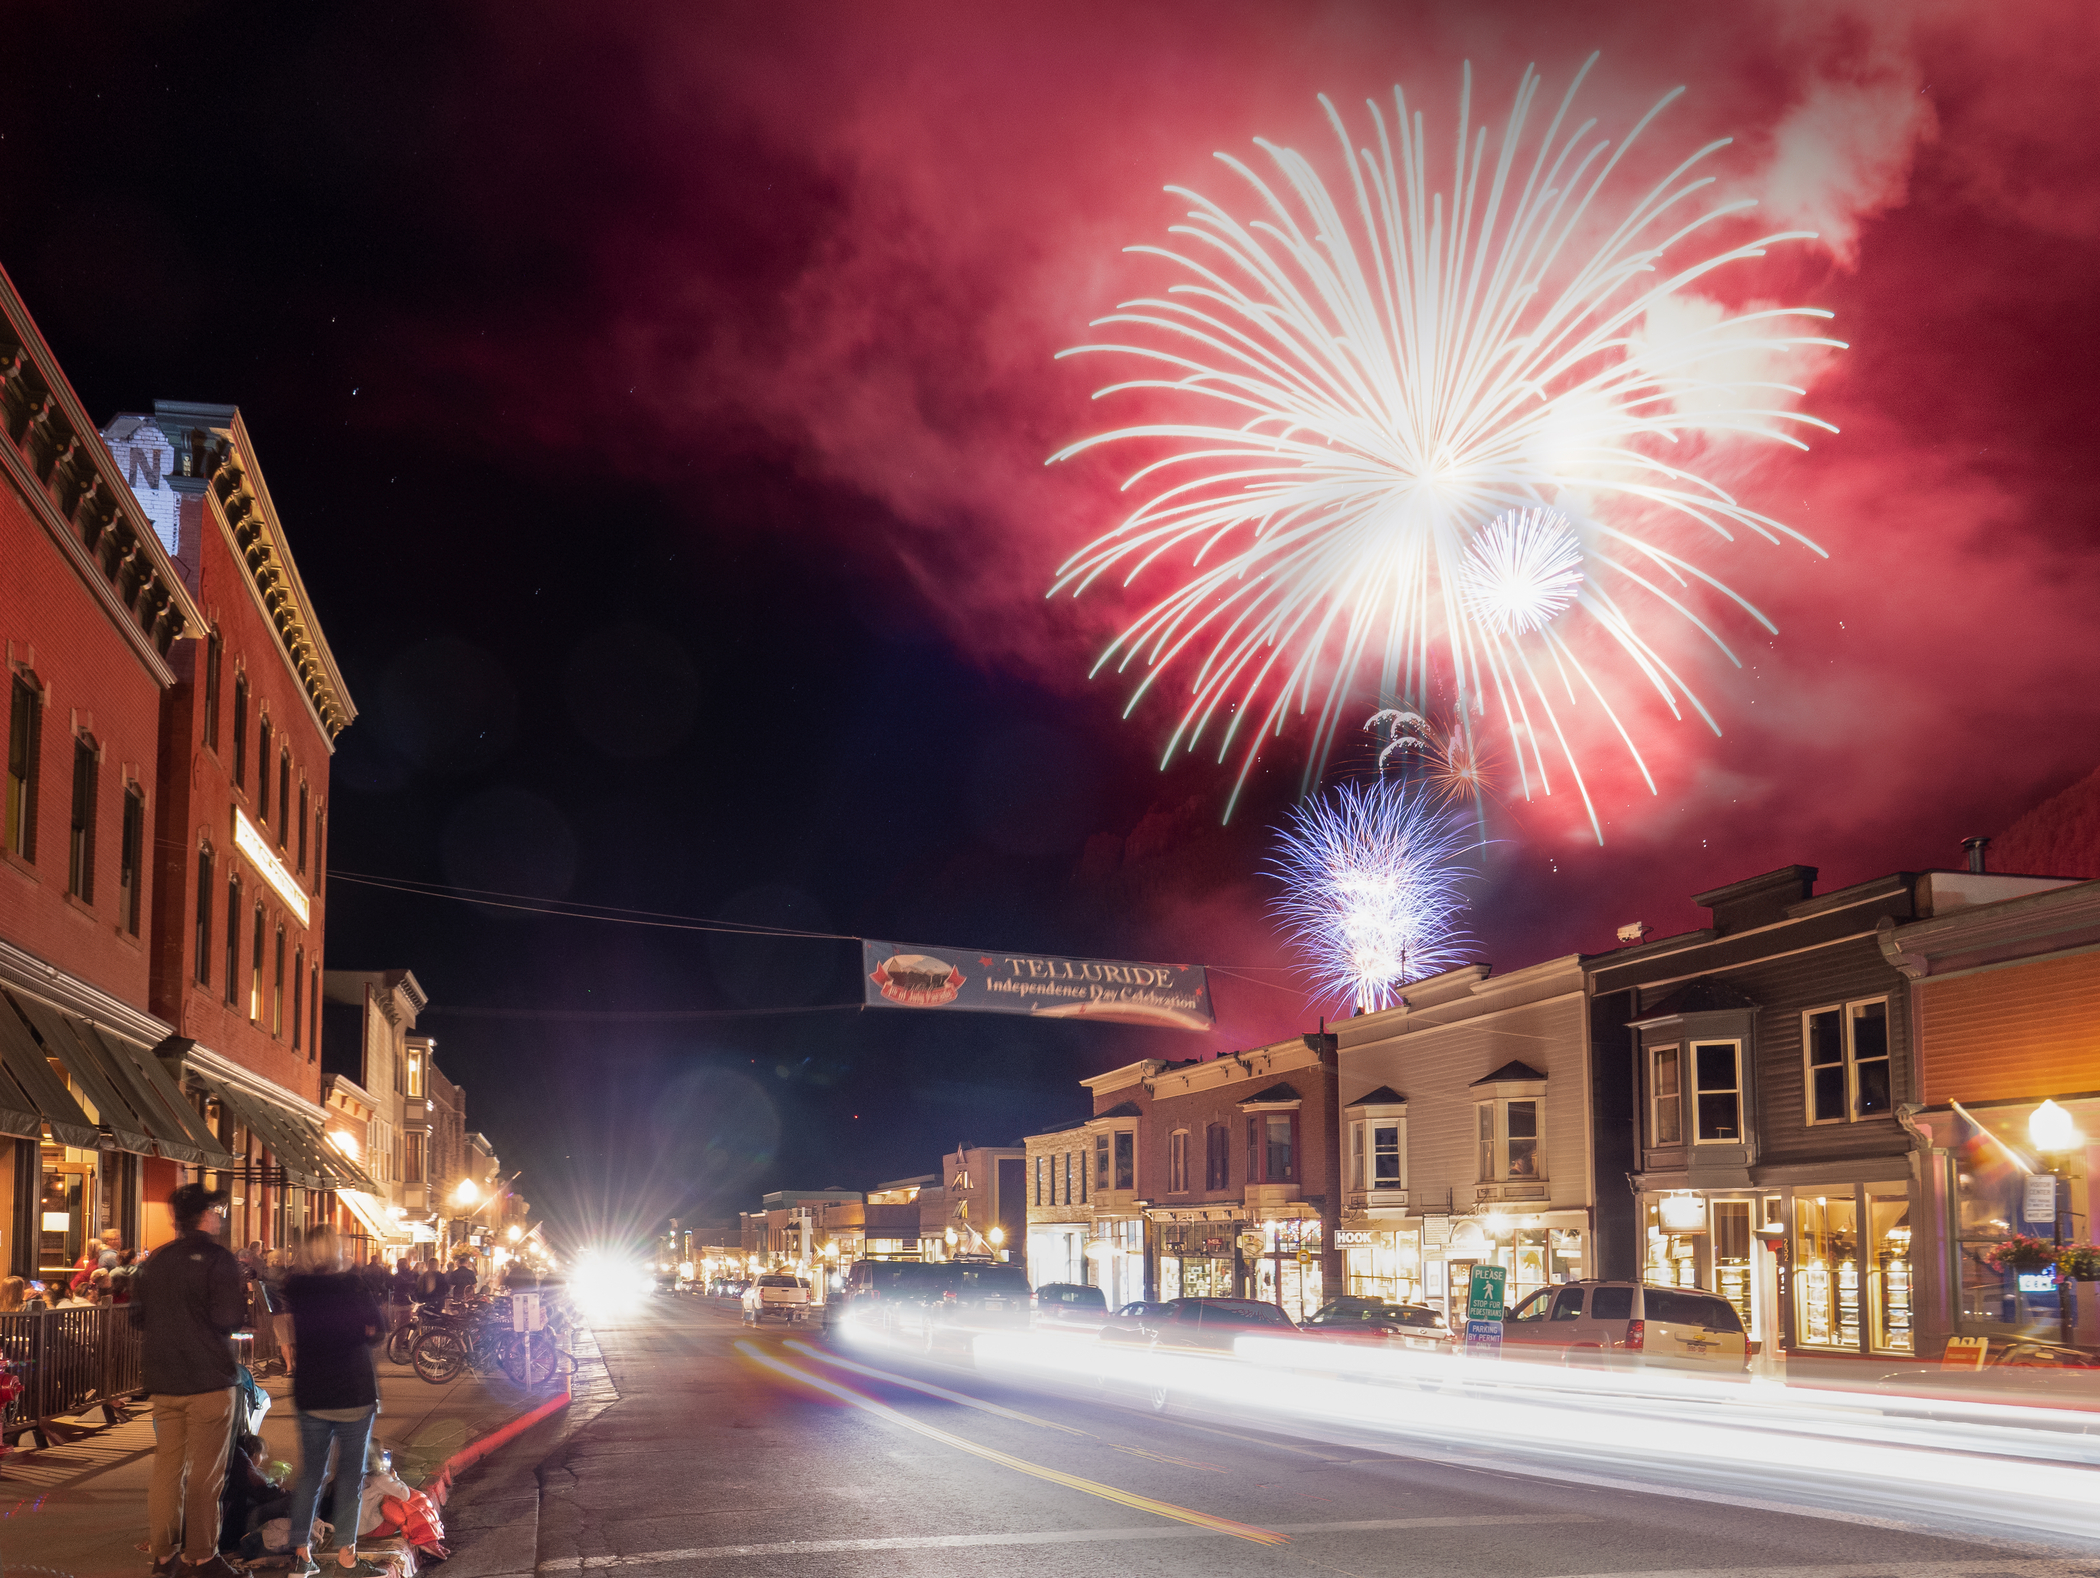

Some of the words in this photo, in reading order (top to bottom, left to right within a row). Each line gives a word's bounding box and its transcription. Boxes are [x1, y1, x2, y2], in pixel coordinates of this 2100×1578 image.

[1004, 958, 1175, 989] TELLURIDE
[986, 976, 1087, 998] Independence
[1089, 983, 1119, 1005] Day
[1119, 986, 1197, 1010] Celebration
[1336, 1232, 1372, 1244] HOOK
[1475, 1269, 1503, 1281] PLEASE
[1473, 1299, 1488, 1308] STOP
[1489, 1301, 1501, 1309] FOR
[1470, 1308, 1502, 1317] PEDESTRIANS
[1472, 1324, 1498, 1334] PARKING
[1468, 1333, 1477, 1341] BY
[1478, 1334, 1500, 1342] PERMIT
[1476, 1342, 1492, 1351] ONLY
